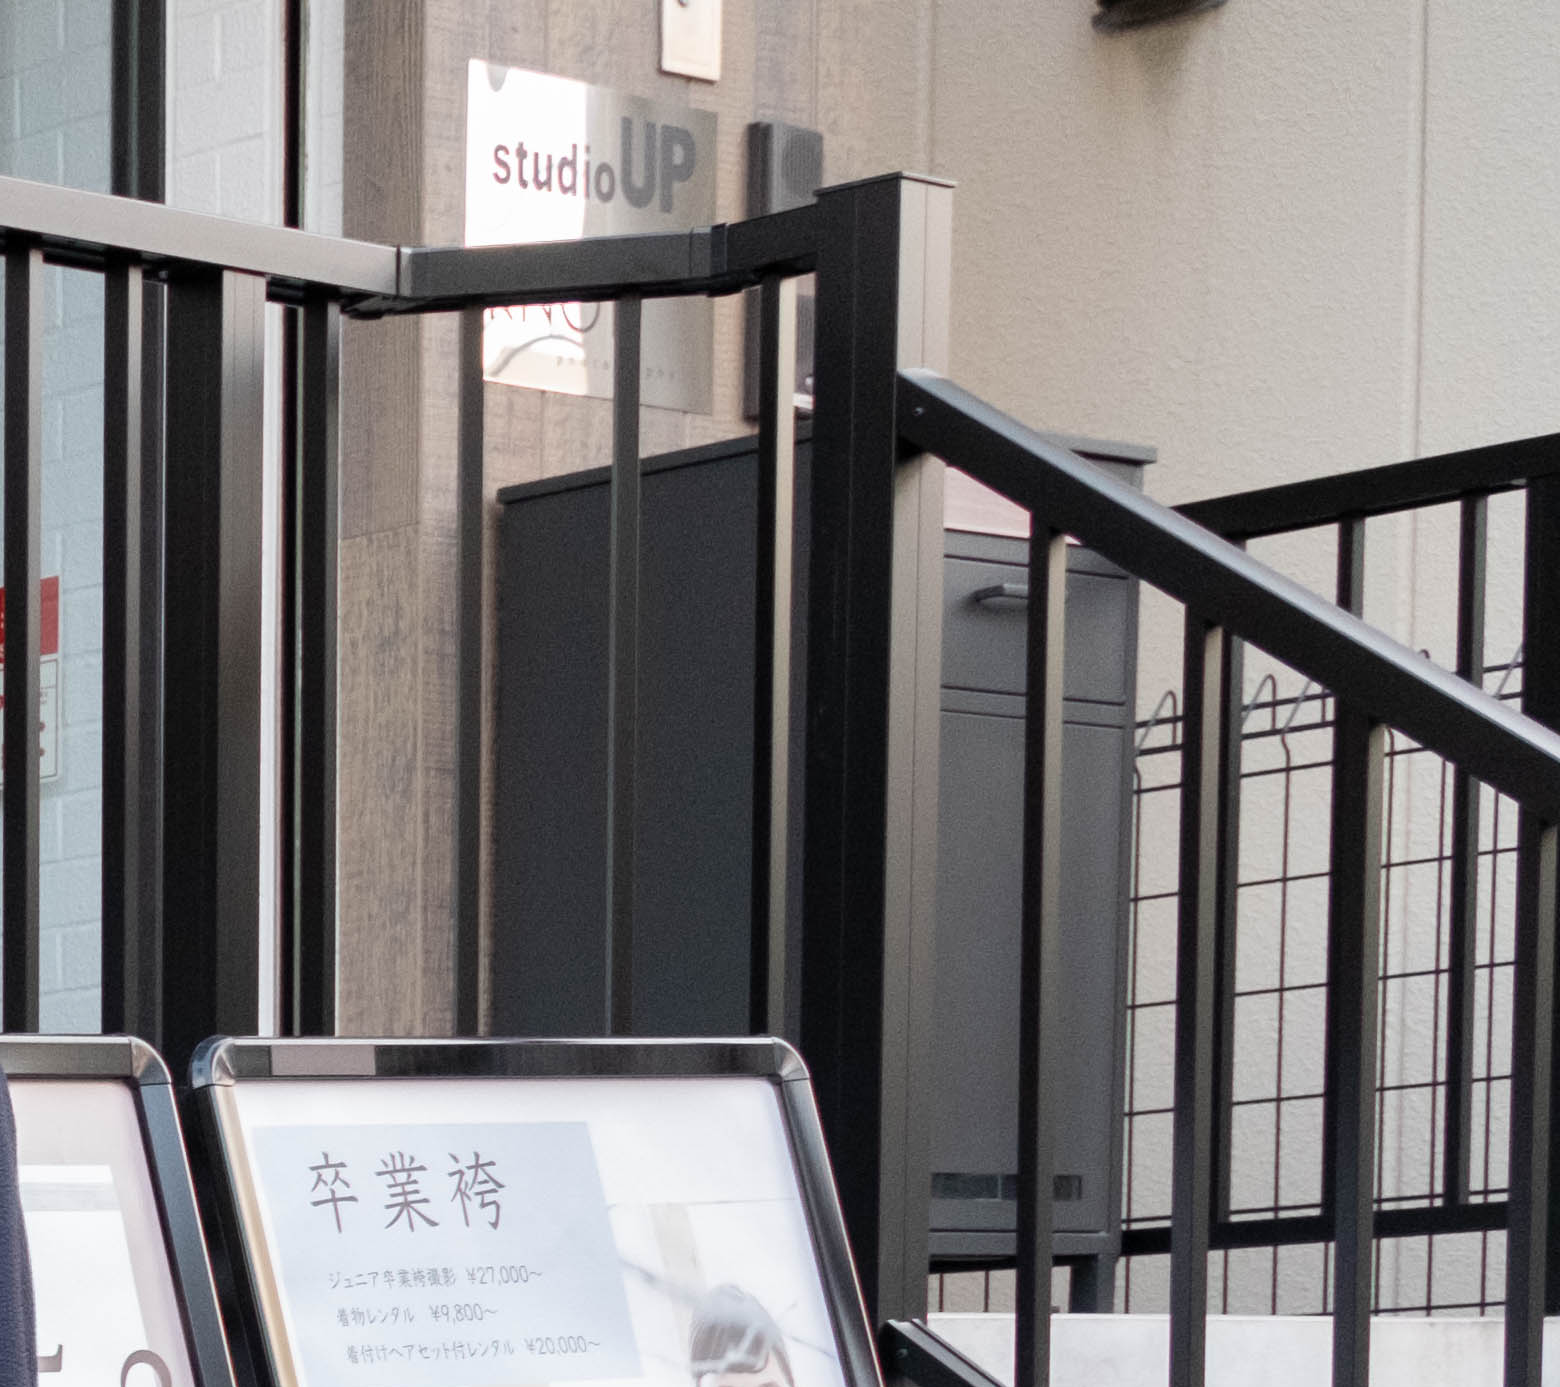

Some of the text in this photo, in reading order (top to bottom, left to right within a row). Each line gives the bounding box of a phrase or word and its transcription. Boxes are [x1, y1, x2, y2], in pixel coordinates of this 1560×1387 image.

[491, 115, 697, 214] studioUP
[308, 1150, 507, 1234] 卒業袴
[335, 1306, 416, 1328] 着物レンタル
